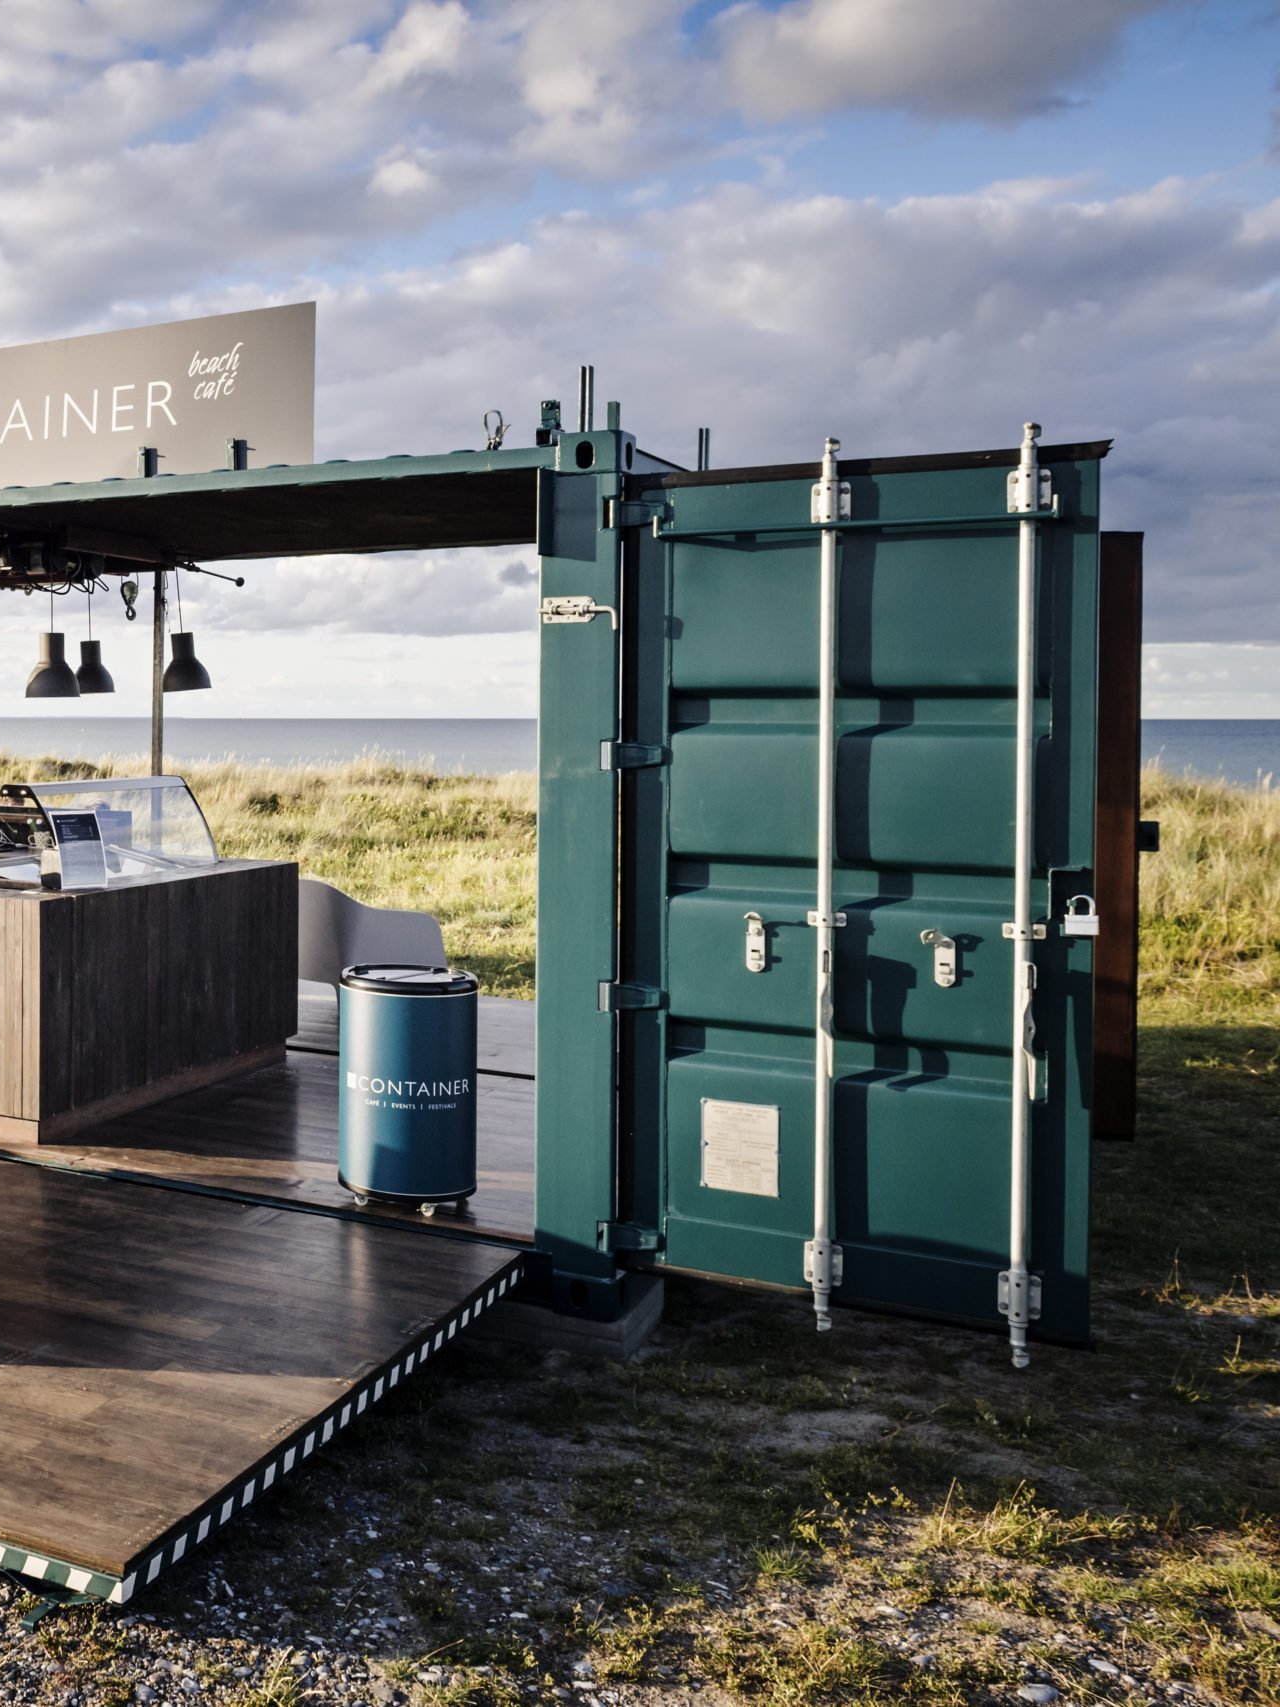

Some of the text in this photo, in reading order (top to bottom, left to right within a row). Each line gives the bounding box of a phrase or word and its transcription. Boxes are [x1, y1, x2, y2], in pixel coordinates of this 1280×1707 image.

[188, 342, 244, 377] beach
[194, 371, 238, 400] café
[358, 1076, 469, 1096] CONTAINER
[391, 1102, 416, 1110] EVENTS
[428, 1102, 456, 1110] FESTIVALS
